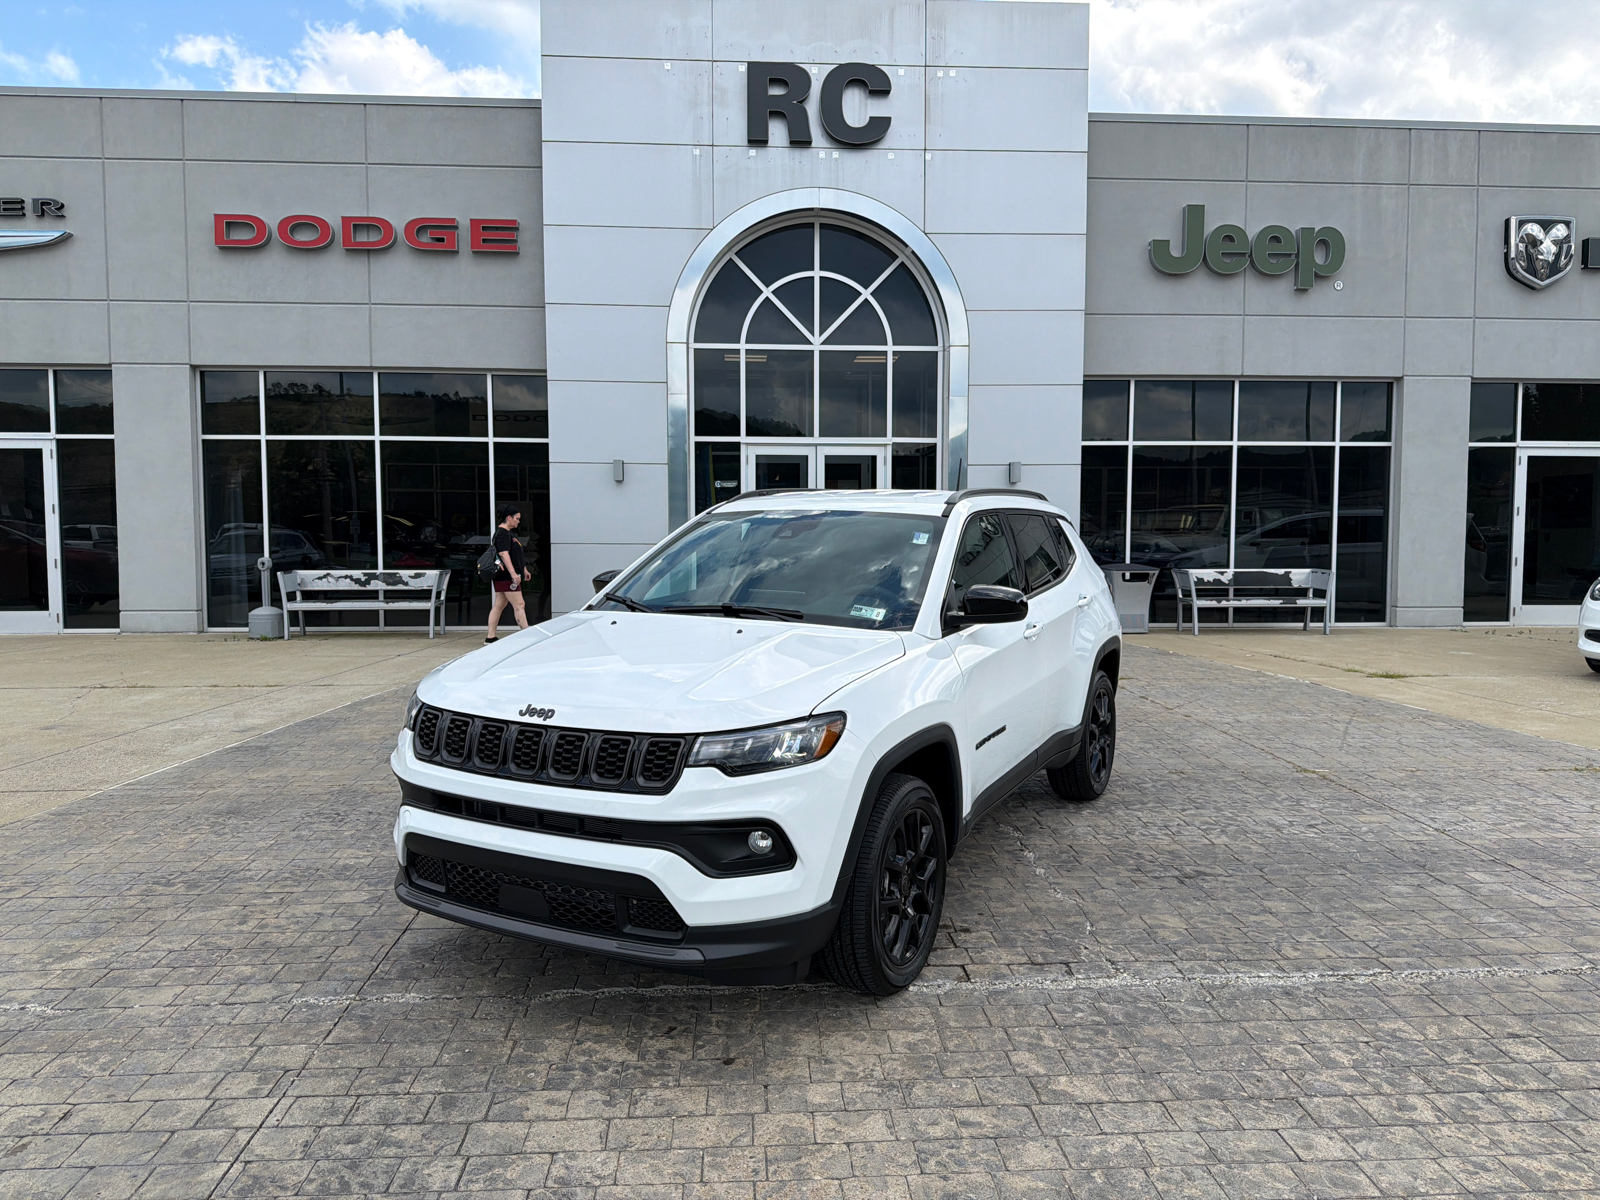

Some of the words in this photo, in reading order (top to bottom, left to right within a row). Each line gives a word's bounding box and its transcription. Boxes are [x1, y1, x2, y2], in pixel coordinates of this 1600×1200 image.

[747, 61, 892, 146] RC
[213, 213, 520, 254] DODGE
[1148, 204, 1347, 291] Jeep
[518, 703, 556, 721] Jeep
